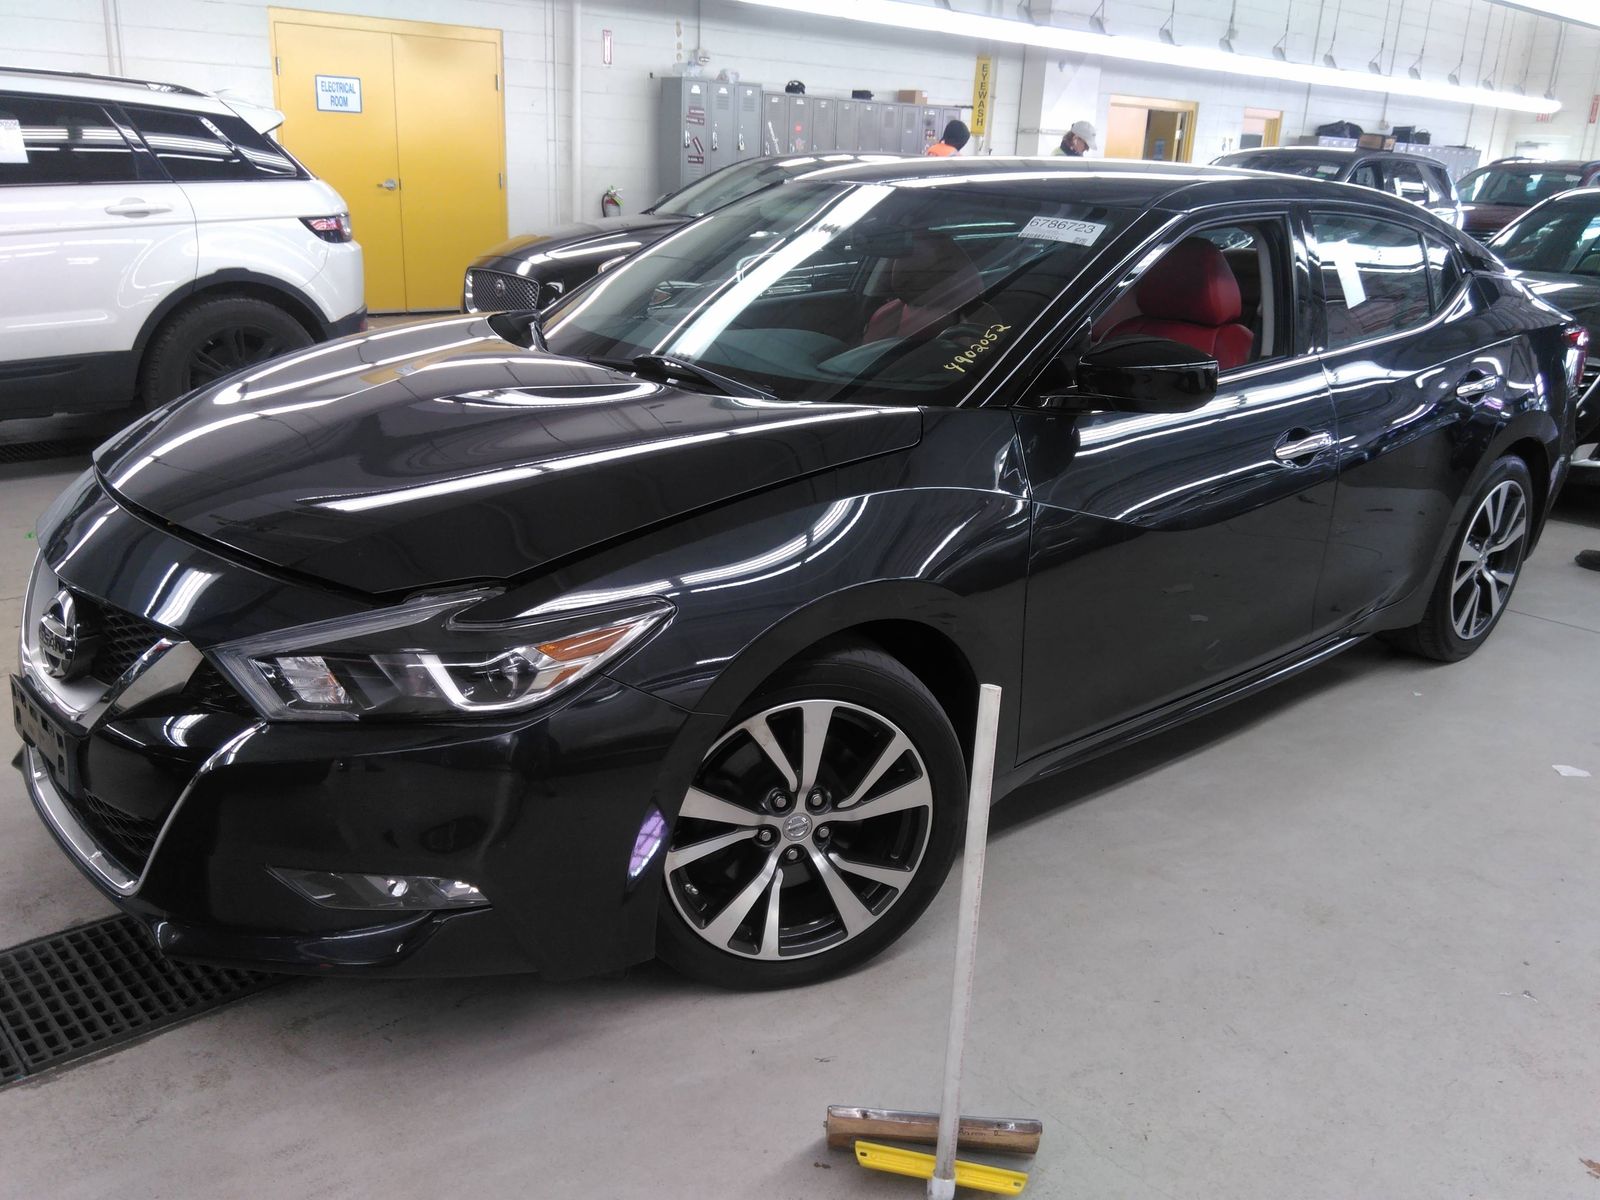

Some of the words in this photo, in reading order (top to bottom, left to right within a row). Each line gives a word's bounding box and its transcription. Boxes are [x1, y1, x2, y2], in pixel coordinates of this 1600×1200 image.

[321, 80, 356, 94] ELECTRICAL
[976, 63, 988, 127] EYEWASH
[330, 95, 348, 107] ROOM
[1029, 218, 1096, 234] 6786723
[943, 324, 1012, 373] 4902052
